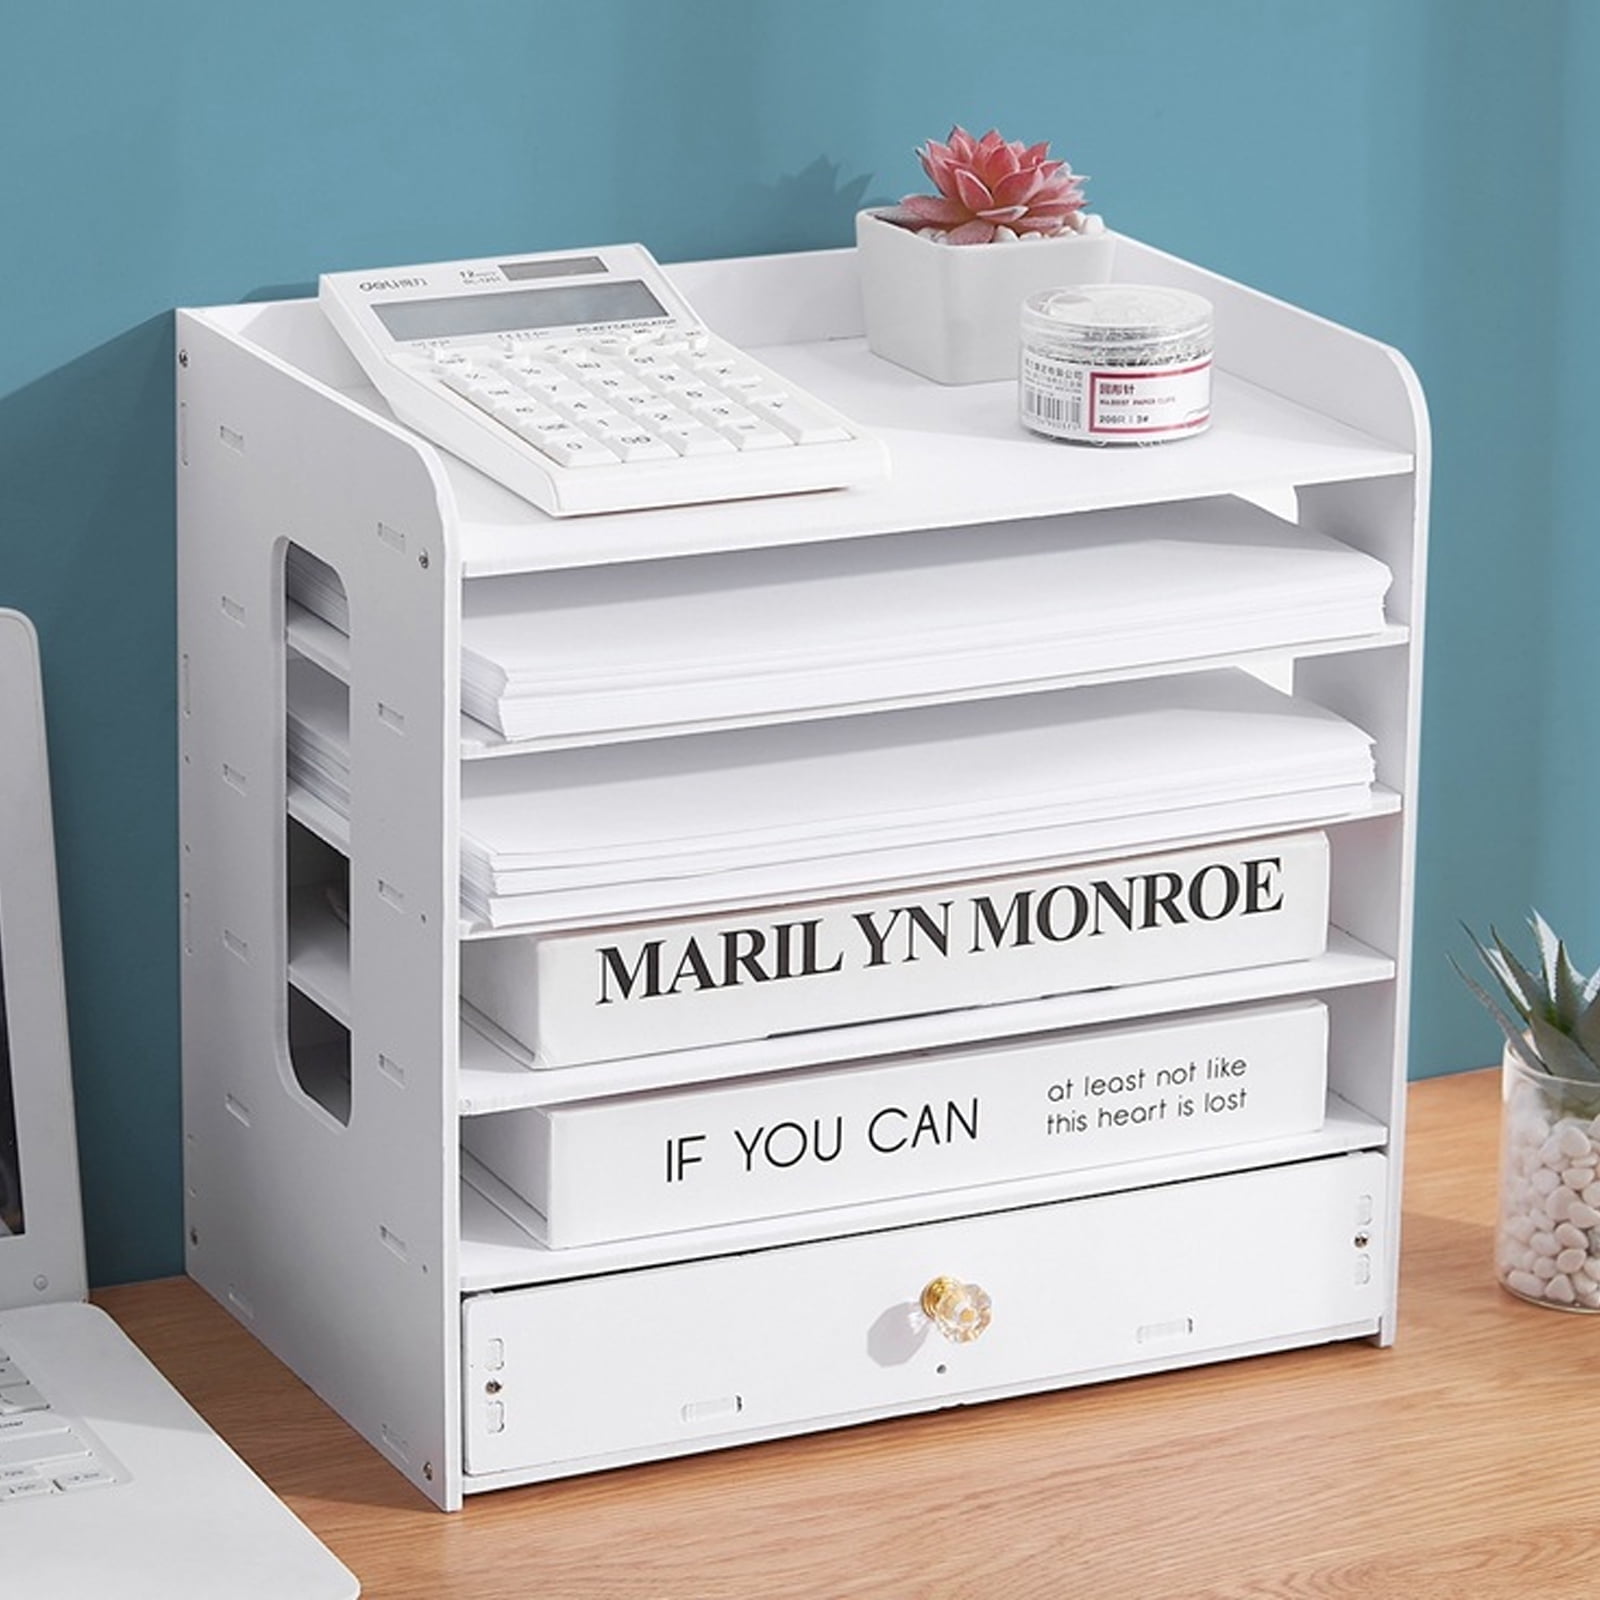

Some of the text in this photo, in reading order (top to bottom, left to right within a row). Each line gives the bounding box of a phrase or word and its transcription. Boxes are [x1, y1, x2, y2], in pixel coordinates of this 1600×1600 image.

[969, 857, 1285, 955] MONROE
[1047, 1057, 1247, 1103] at least not like
[1047, 1087, 1248, 1136] this heart is lost
[666, 1097, 979, 1183] IF YOU CAN
